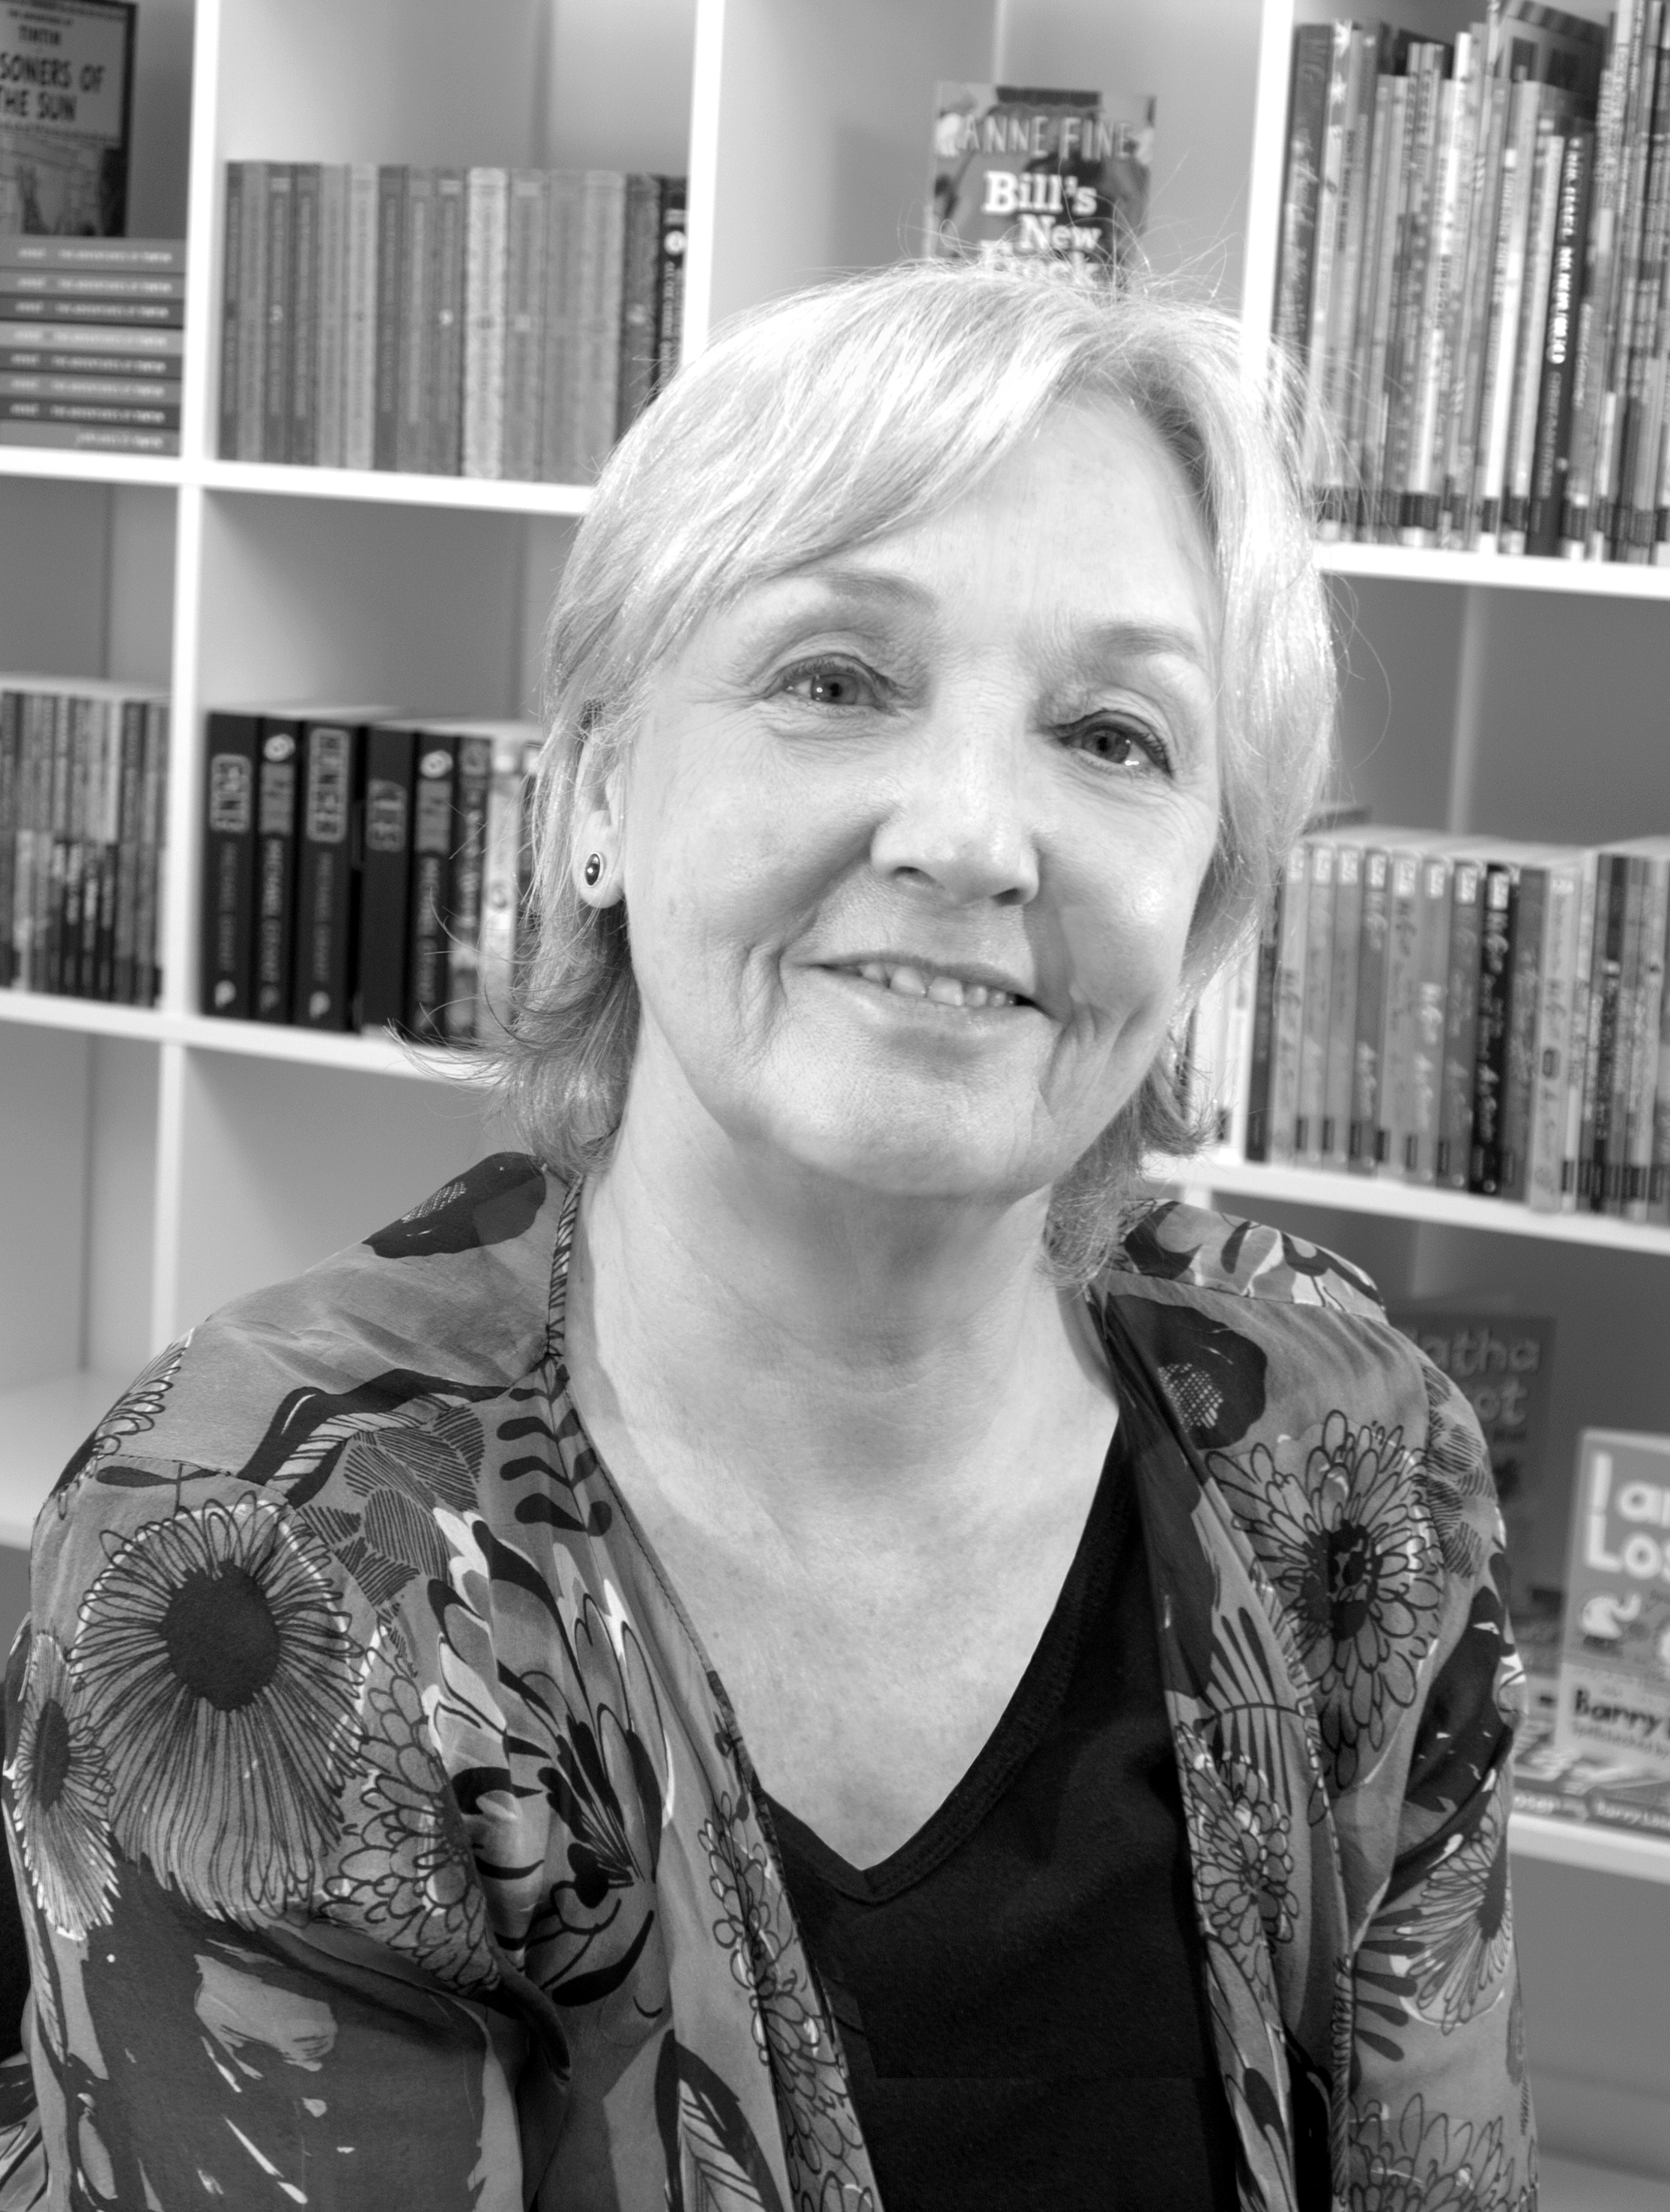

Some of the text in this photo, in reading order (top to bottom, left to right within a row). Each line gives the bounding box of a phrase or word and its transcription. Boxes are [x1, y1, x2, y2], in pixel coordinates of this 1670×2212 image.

[80, 64, 105, 94] OF
[38, 91, 76, 122] SUN
[958, 114, 1134, 163] ANNE FINE
[982, 169, 1098, 216] Bill's
[1017, 213, 1102, 252] New
